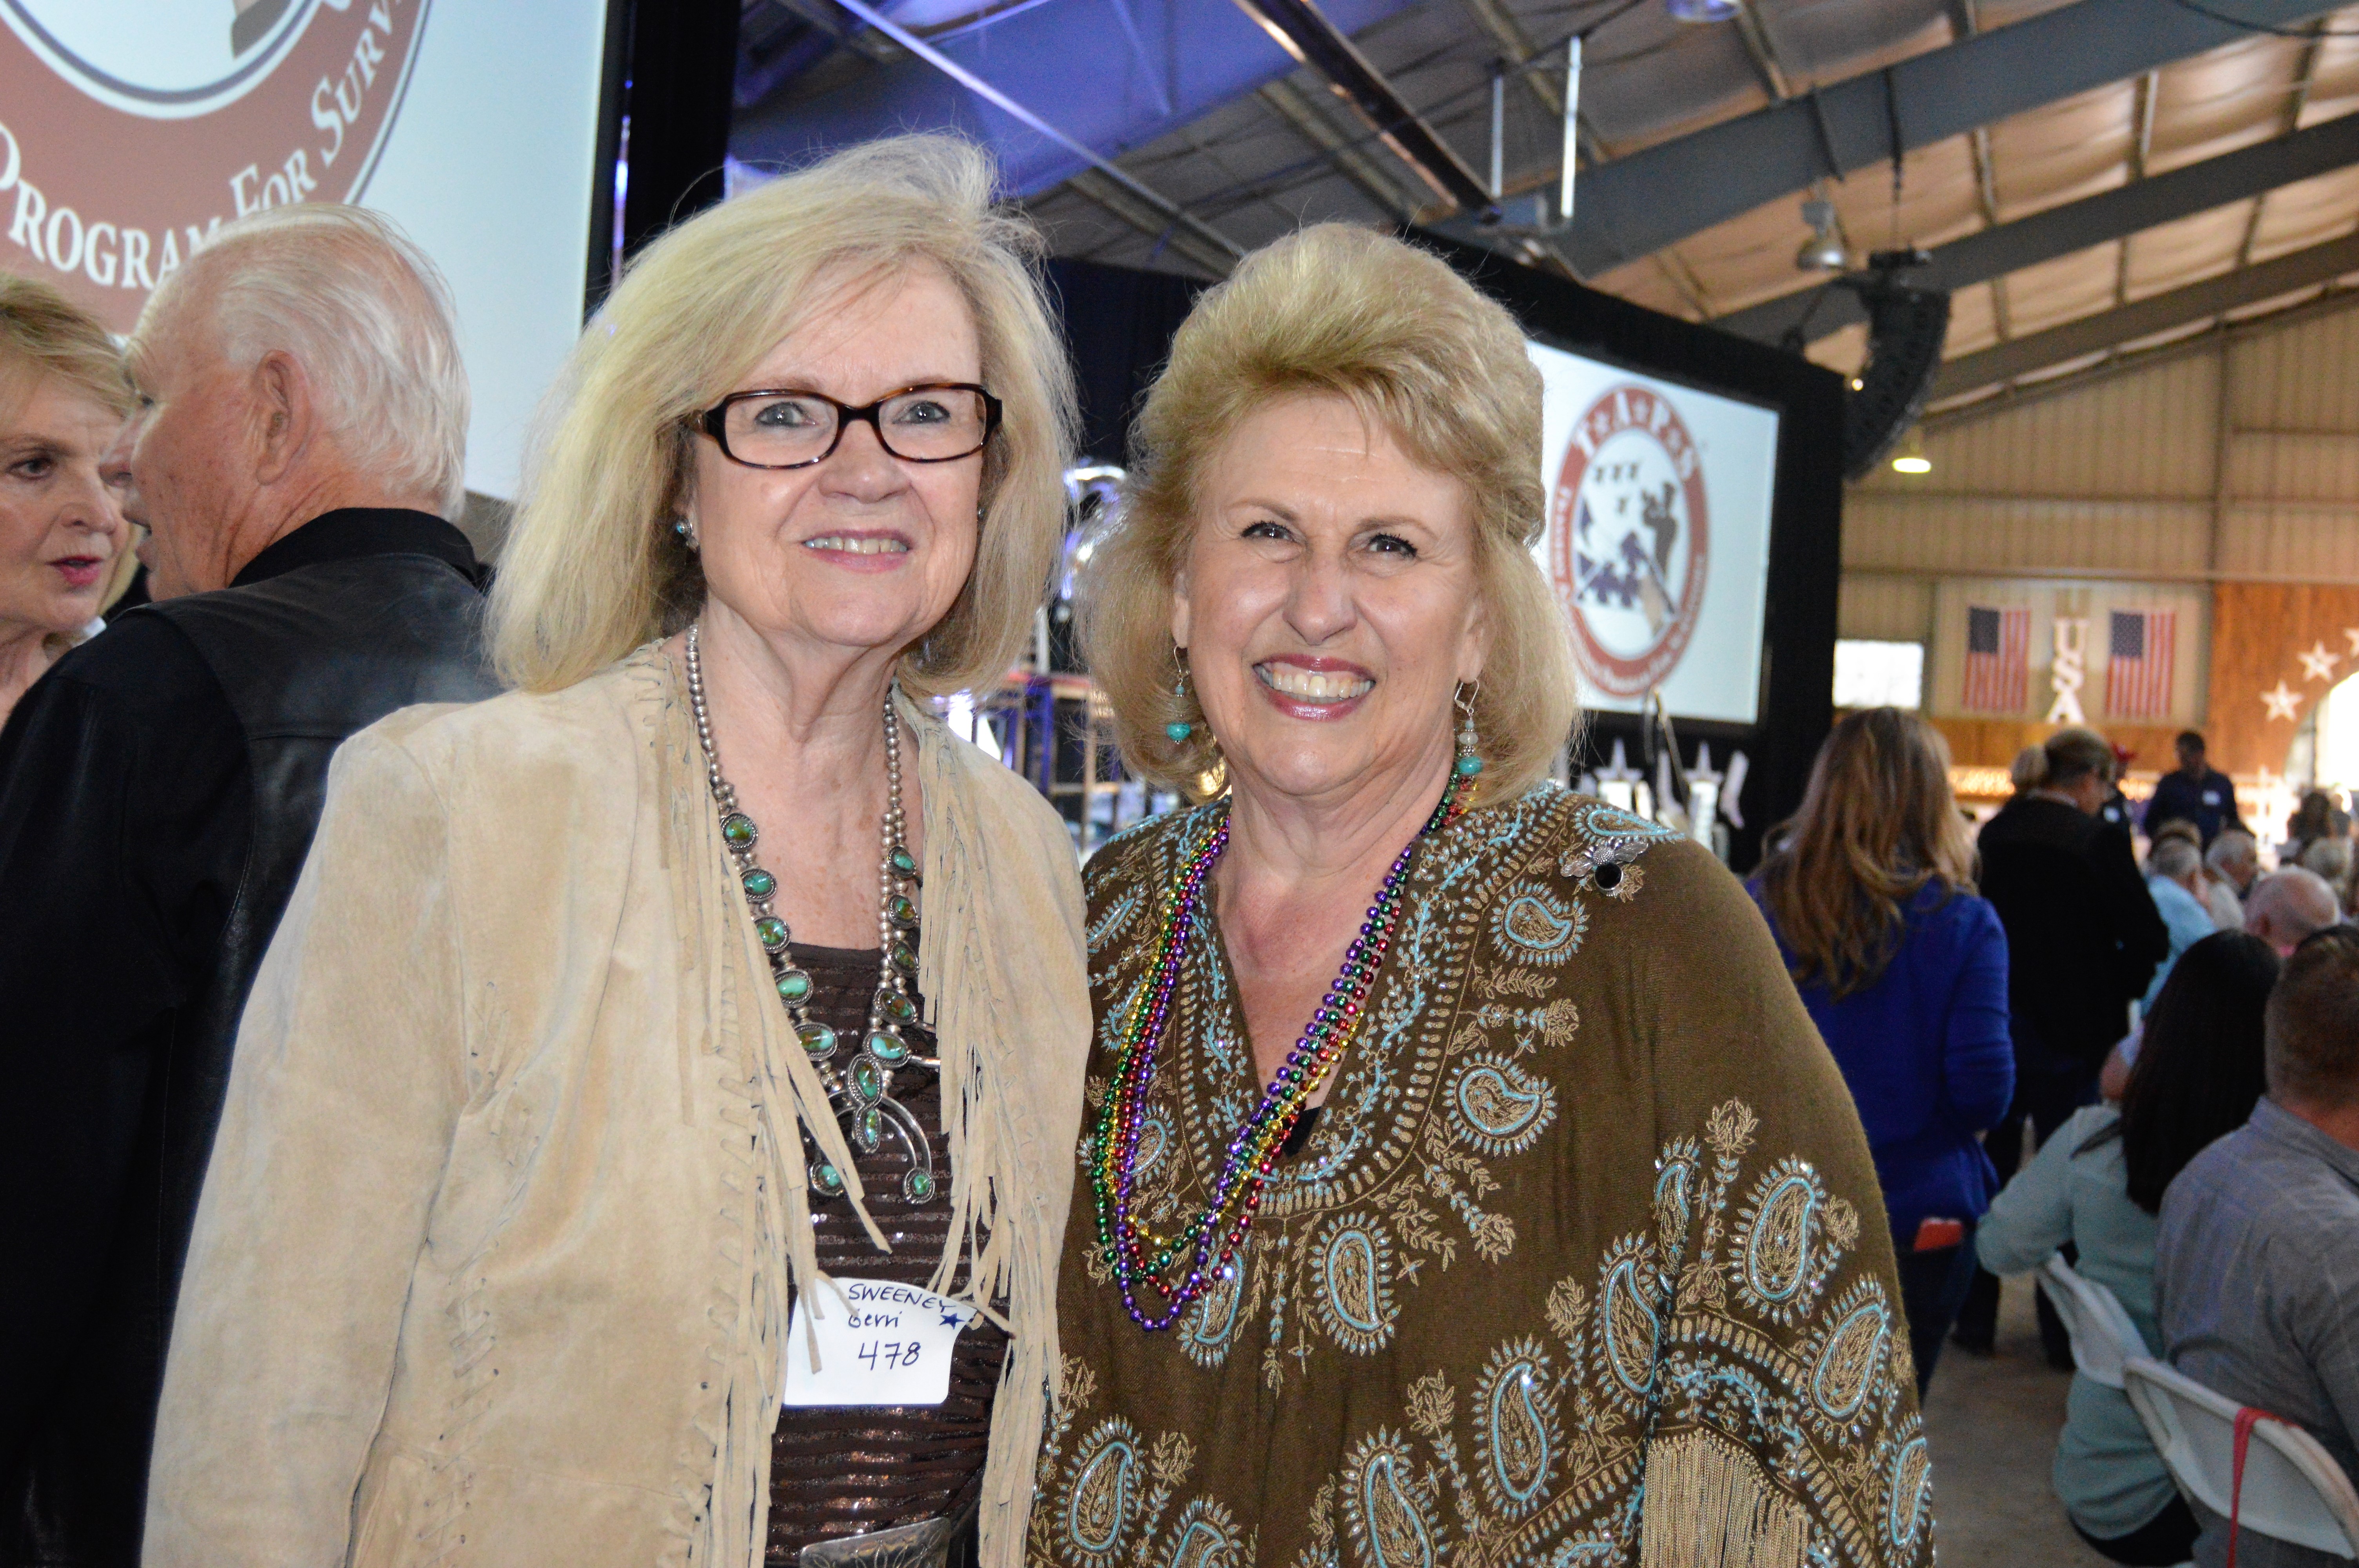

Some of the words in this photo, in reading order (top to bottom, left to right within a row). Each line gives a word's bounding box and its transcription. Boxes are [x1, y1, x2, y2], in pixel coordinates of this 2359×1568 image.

[2045, 617, 2089, 724] USA
[848, 1283, 957, 1313] SWEENEY
[858, 1340, 921, 1371] 478
